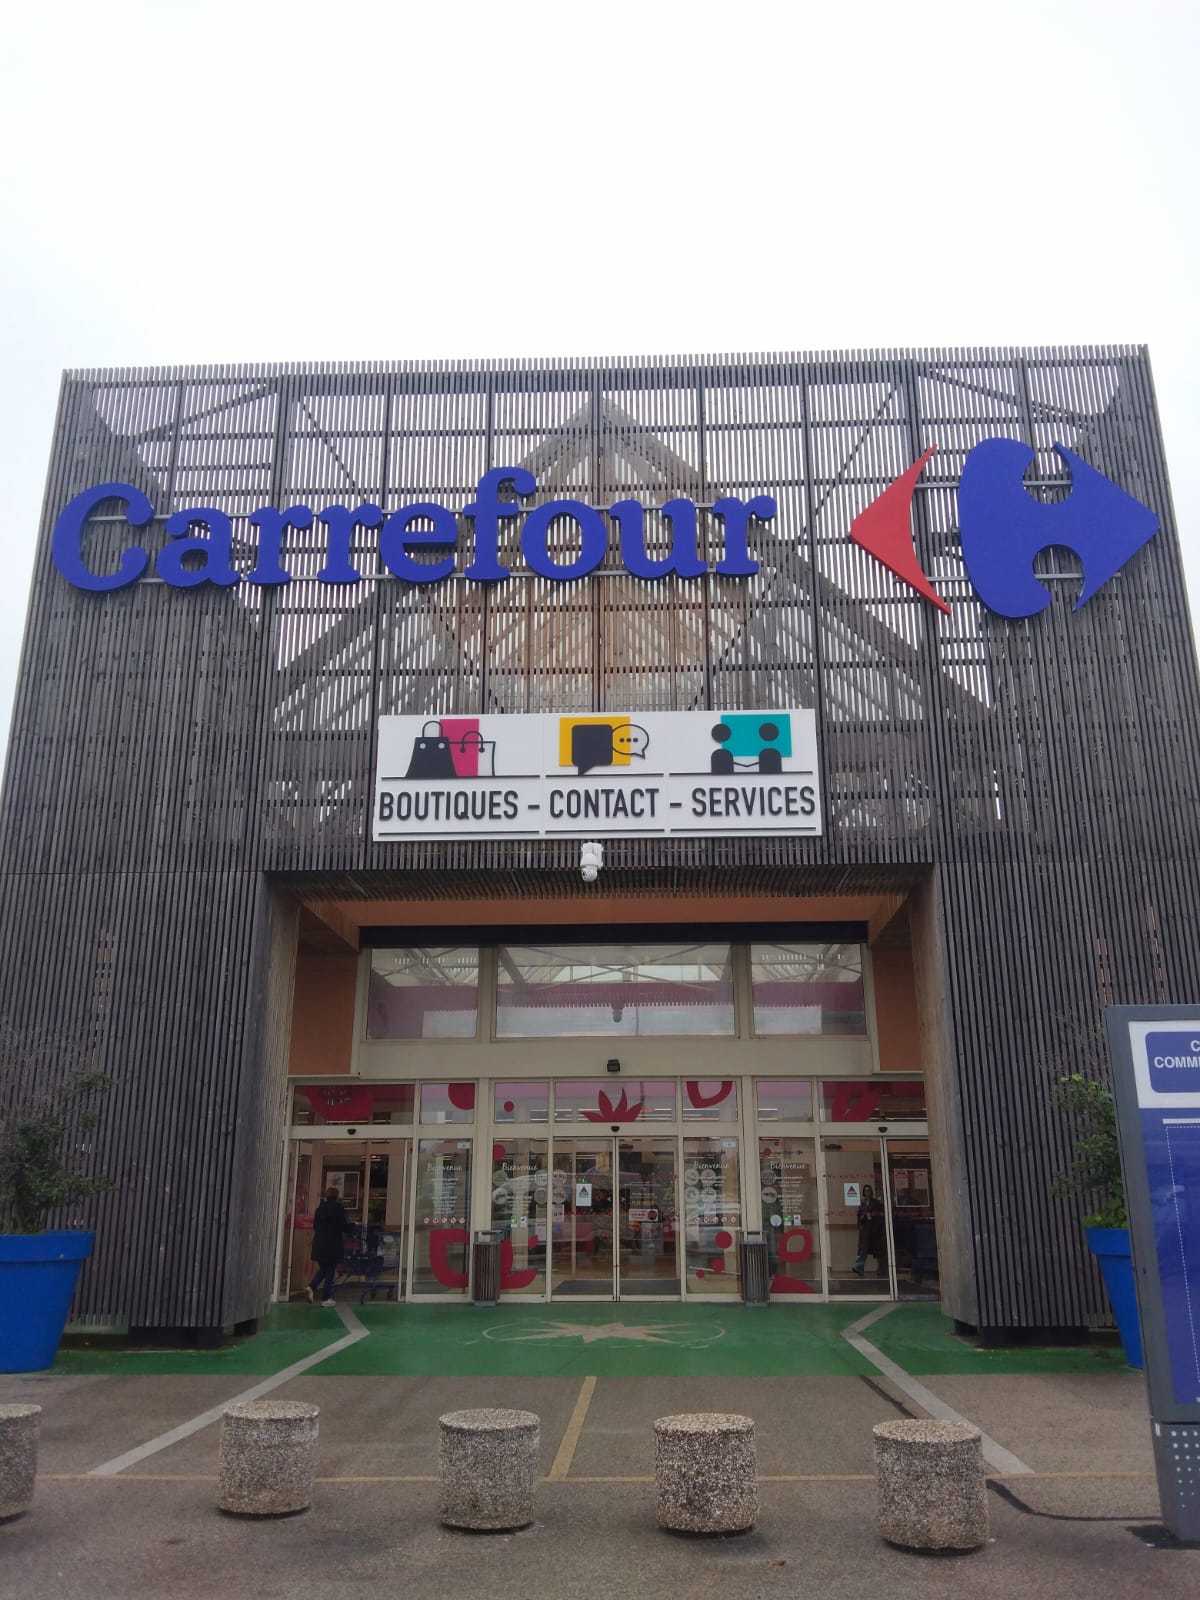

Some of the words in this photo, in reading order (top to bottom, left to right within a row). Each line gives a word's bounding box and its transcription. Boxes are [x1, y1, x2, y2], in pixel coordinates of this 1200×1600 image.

[52, 465, 778, 592] Carrefour
[378, 790, 519, 821] BOUTIQUES
[549, 788, 660, 818] CONTACT
[691, 786, 816, 817] SERVICES
[1154, 1056, 1200, 1068] COMM
